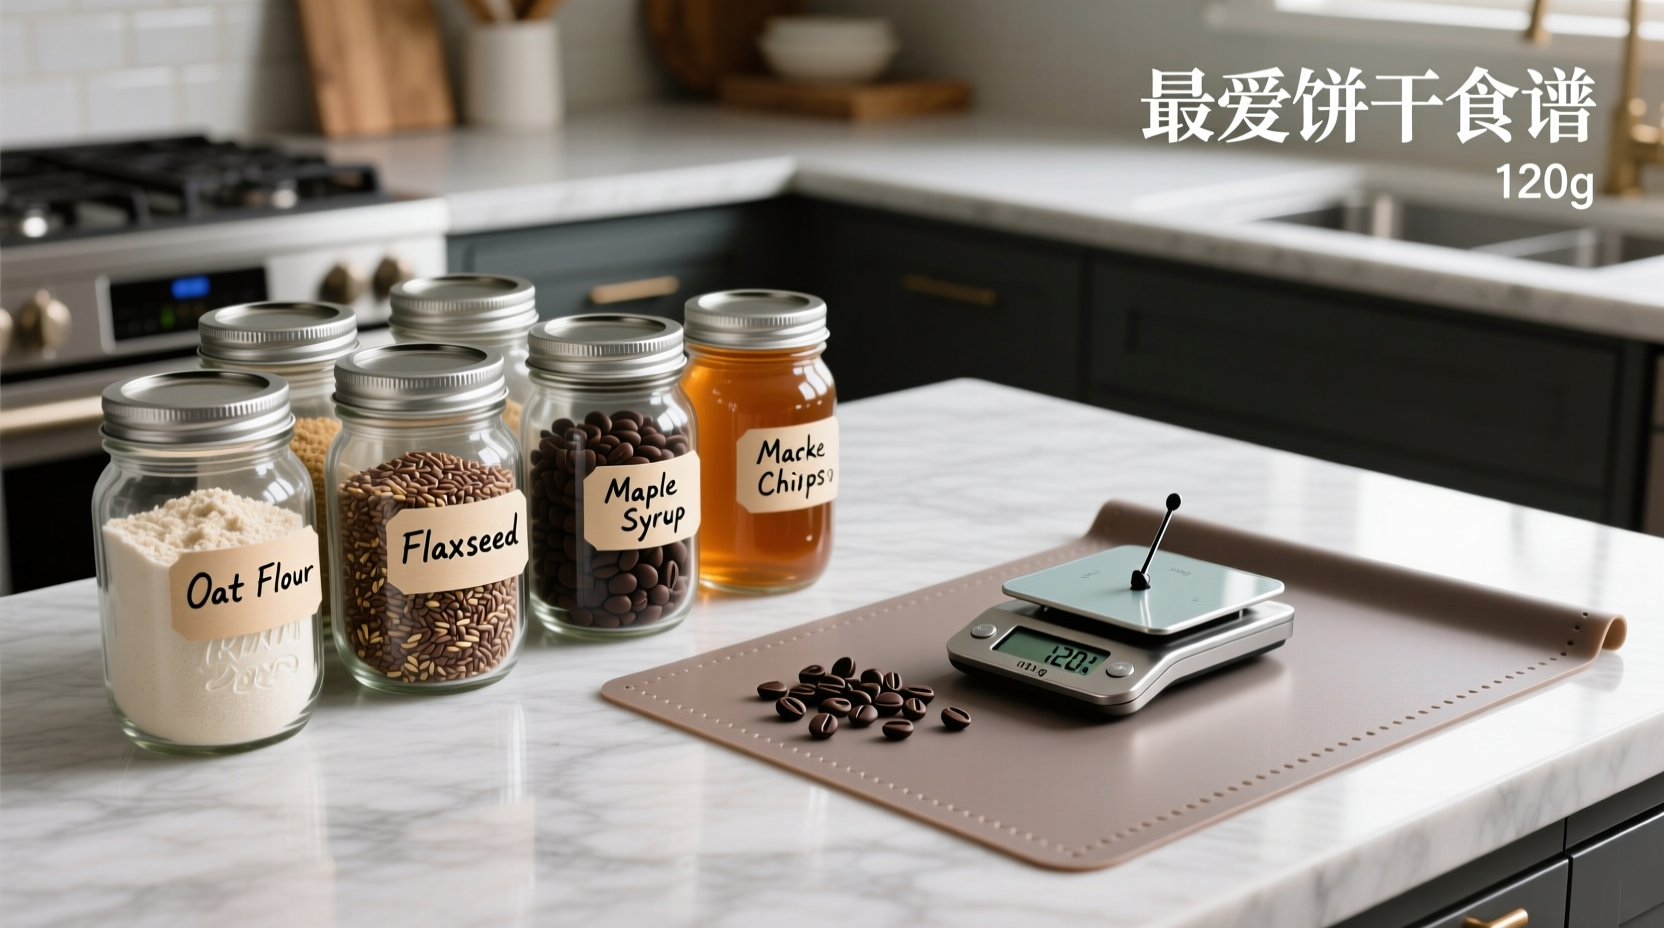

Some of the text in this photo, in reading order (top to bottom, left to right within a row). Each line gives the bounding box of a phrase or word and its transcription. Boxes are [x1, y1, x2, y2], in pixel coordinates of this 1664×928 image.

[604, 472, 677, 509] Maple
[403, 513, 518, 564] Flaxseed
[621, 506, 685, 542] Syrup
[187, 562, 313, 609] Oat Flour
